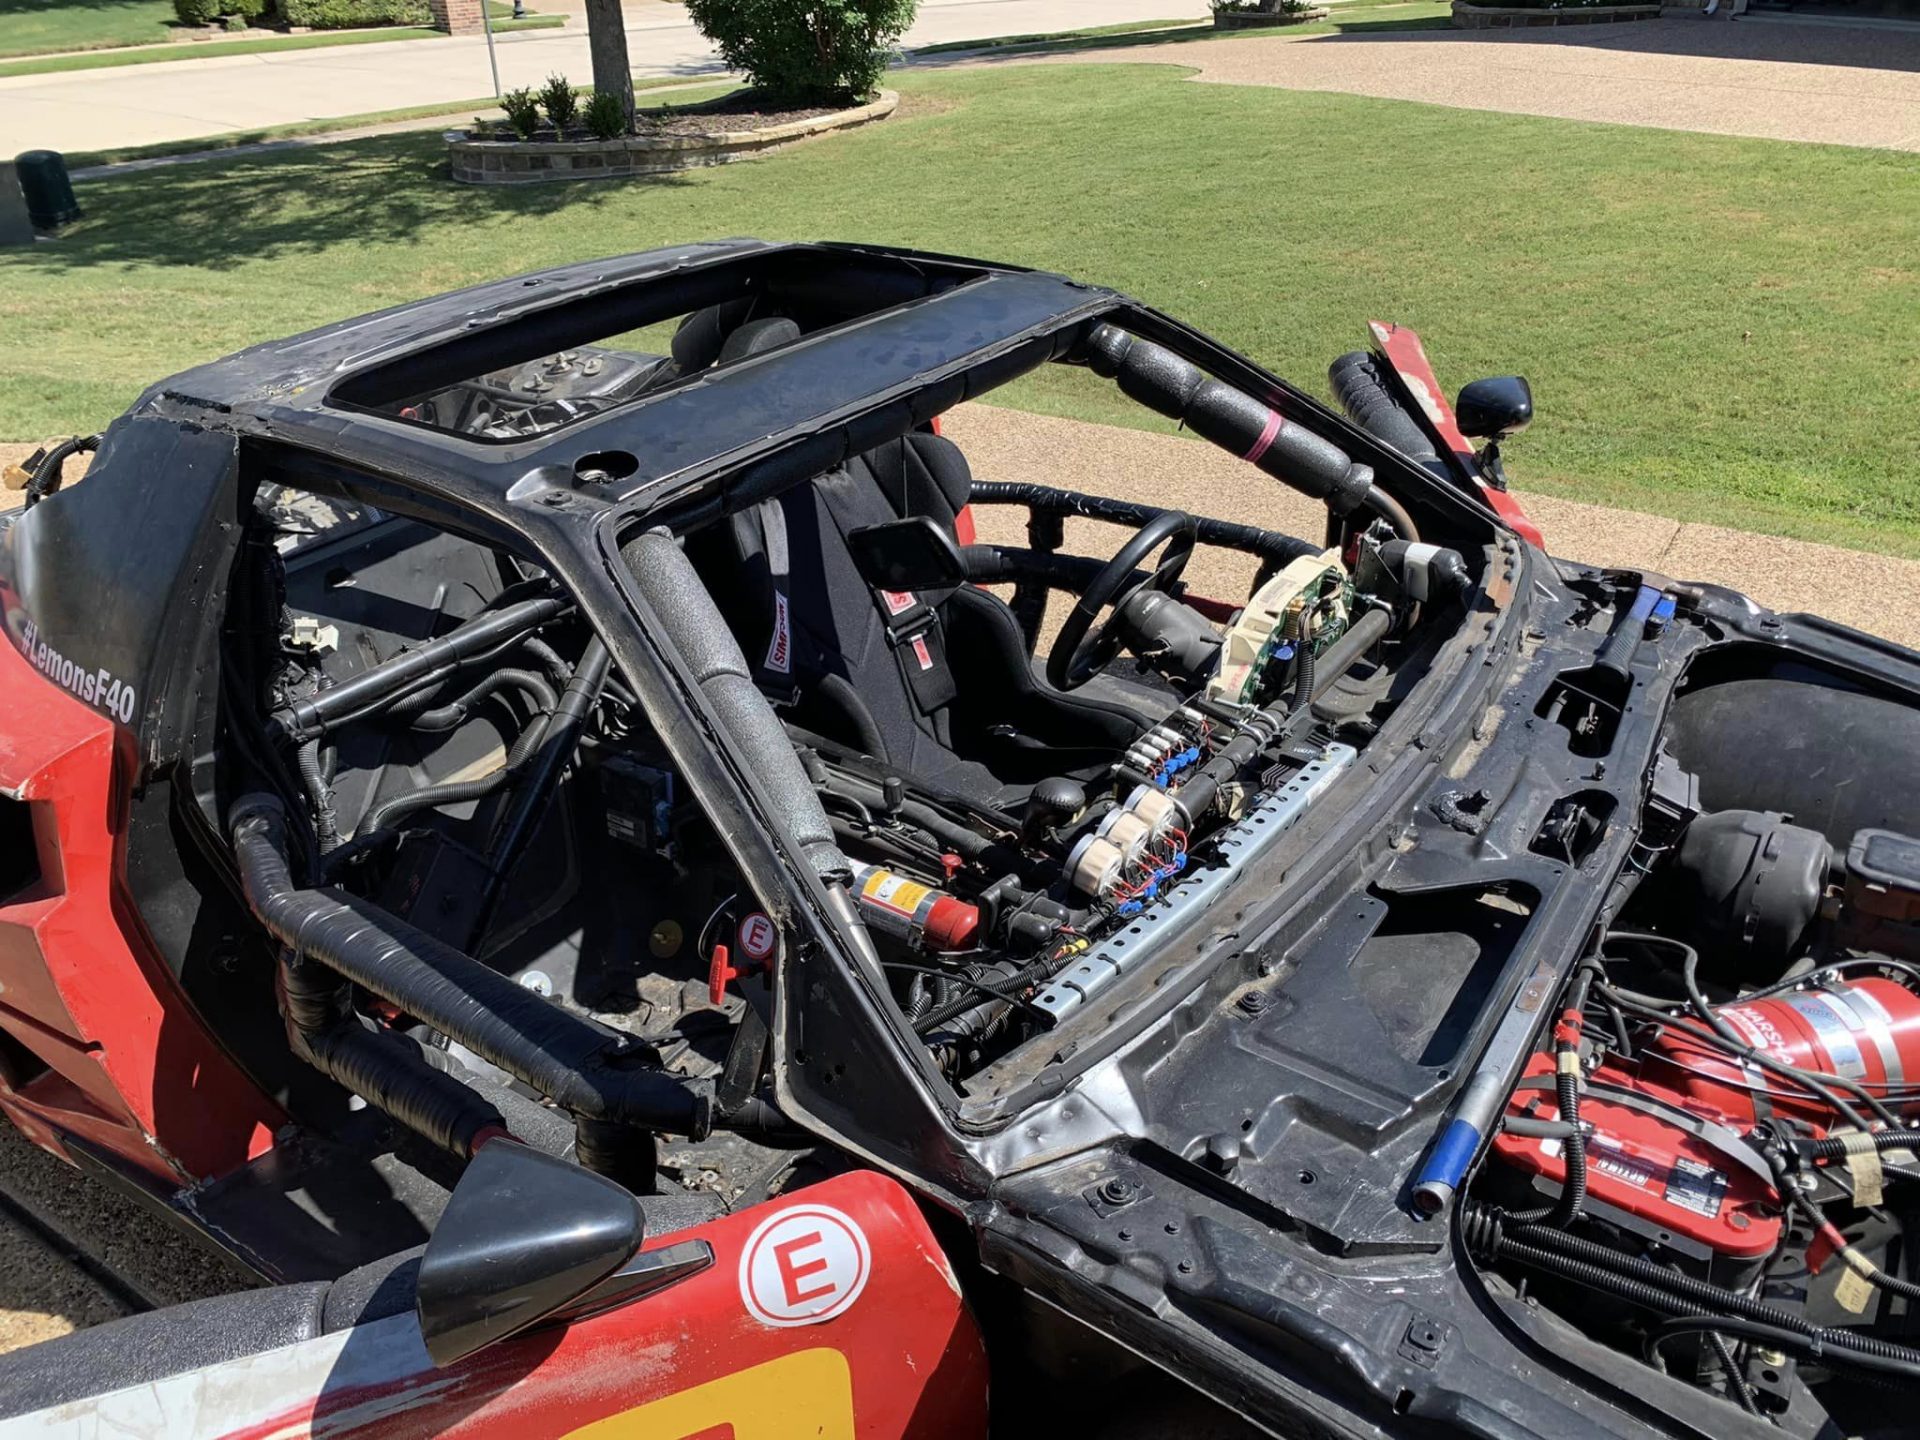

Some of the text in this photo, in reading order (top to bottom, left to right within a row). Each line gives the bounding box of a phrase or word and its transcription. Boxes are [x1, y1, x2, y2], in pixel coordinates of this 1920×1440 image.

[23, 619, 136, 724] #LemonsF40
[748, 923, 768, 950] E
[1598, 1159, 1647, 1185] OPTIMA
[773, 1231, 836, 1307] E
